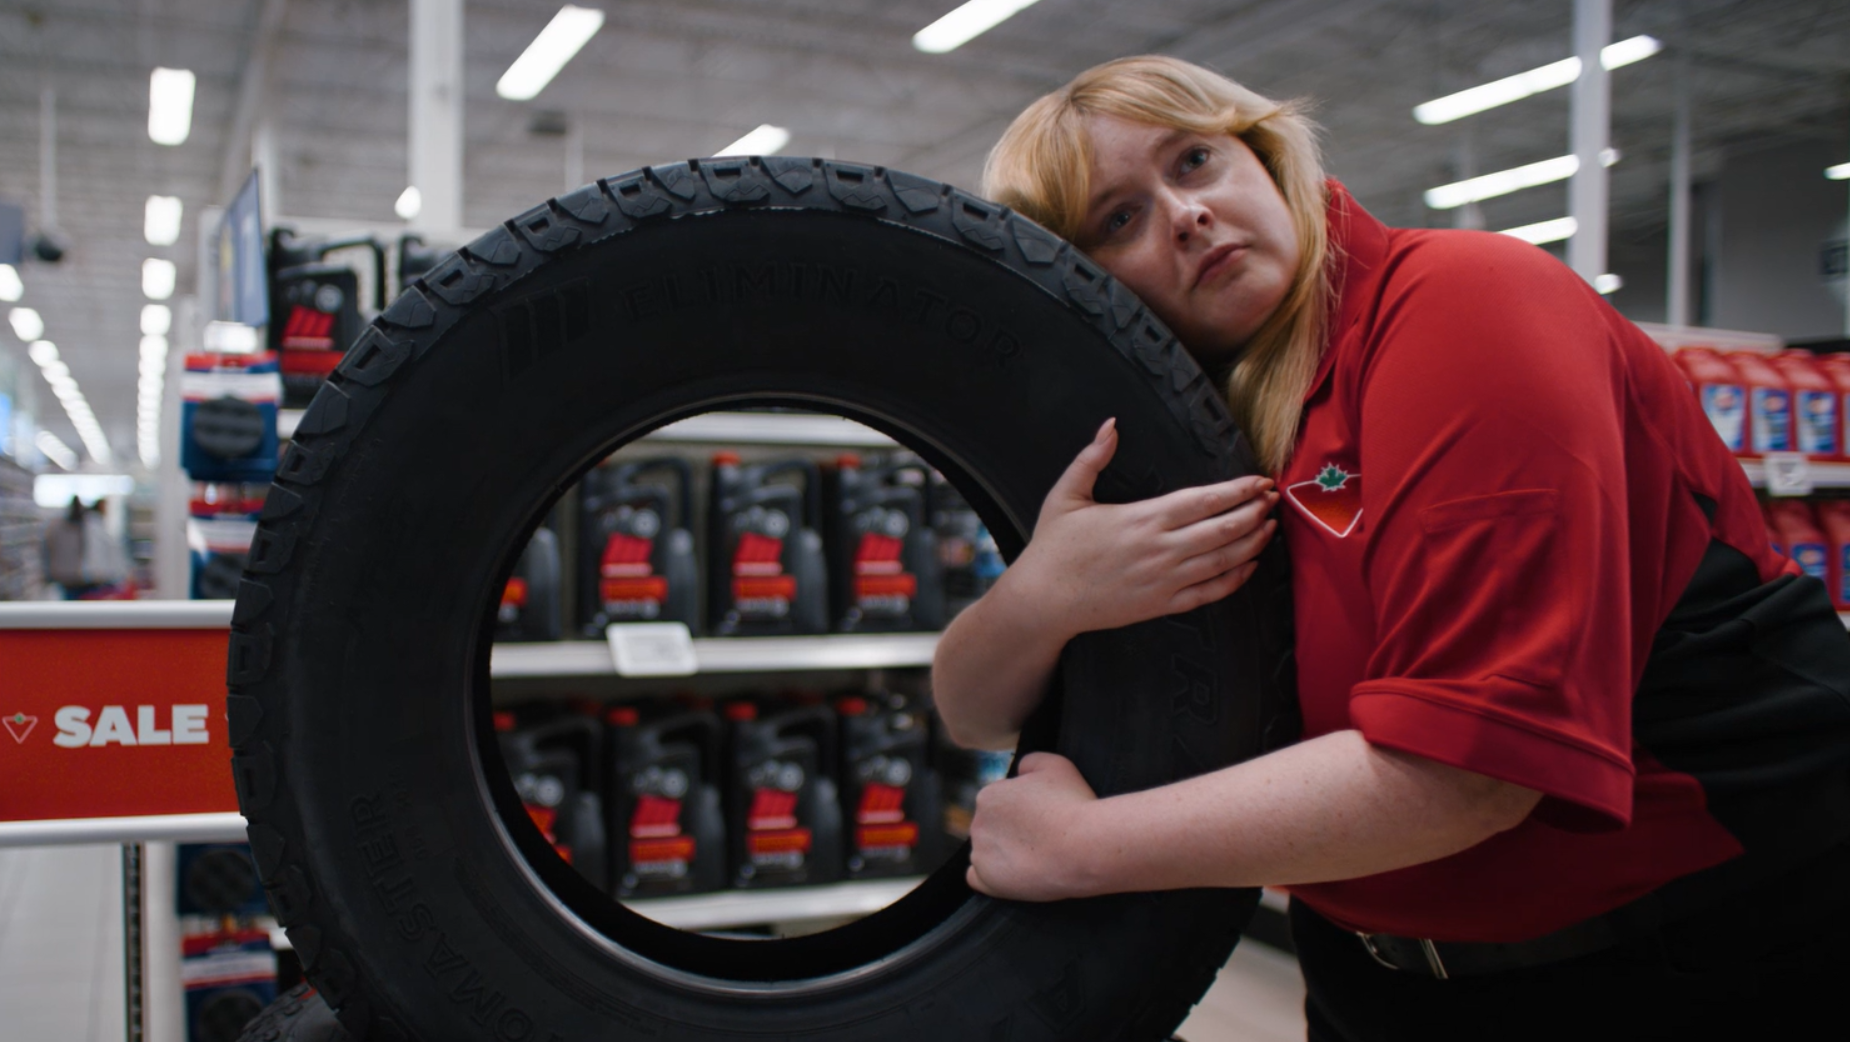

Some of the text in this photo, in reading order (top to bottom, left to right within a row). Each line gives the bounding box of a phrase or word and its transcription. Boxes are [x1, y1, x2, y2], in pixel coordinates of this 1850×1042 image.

[619, 261, 1025, 368] ELIMINATOR
[53, 704, 209, 748] SALE
[348, 789, 565, 1042] OMASTER
